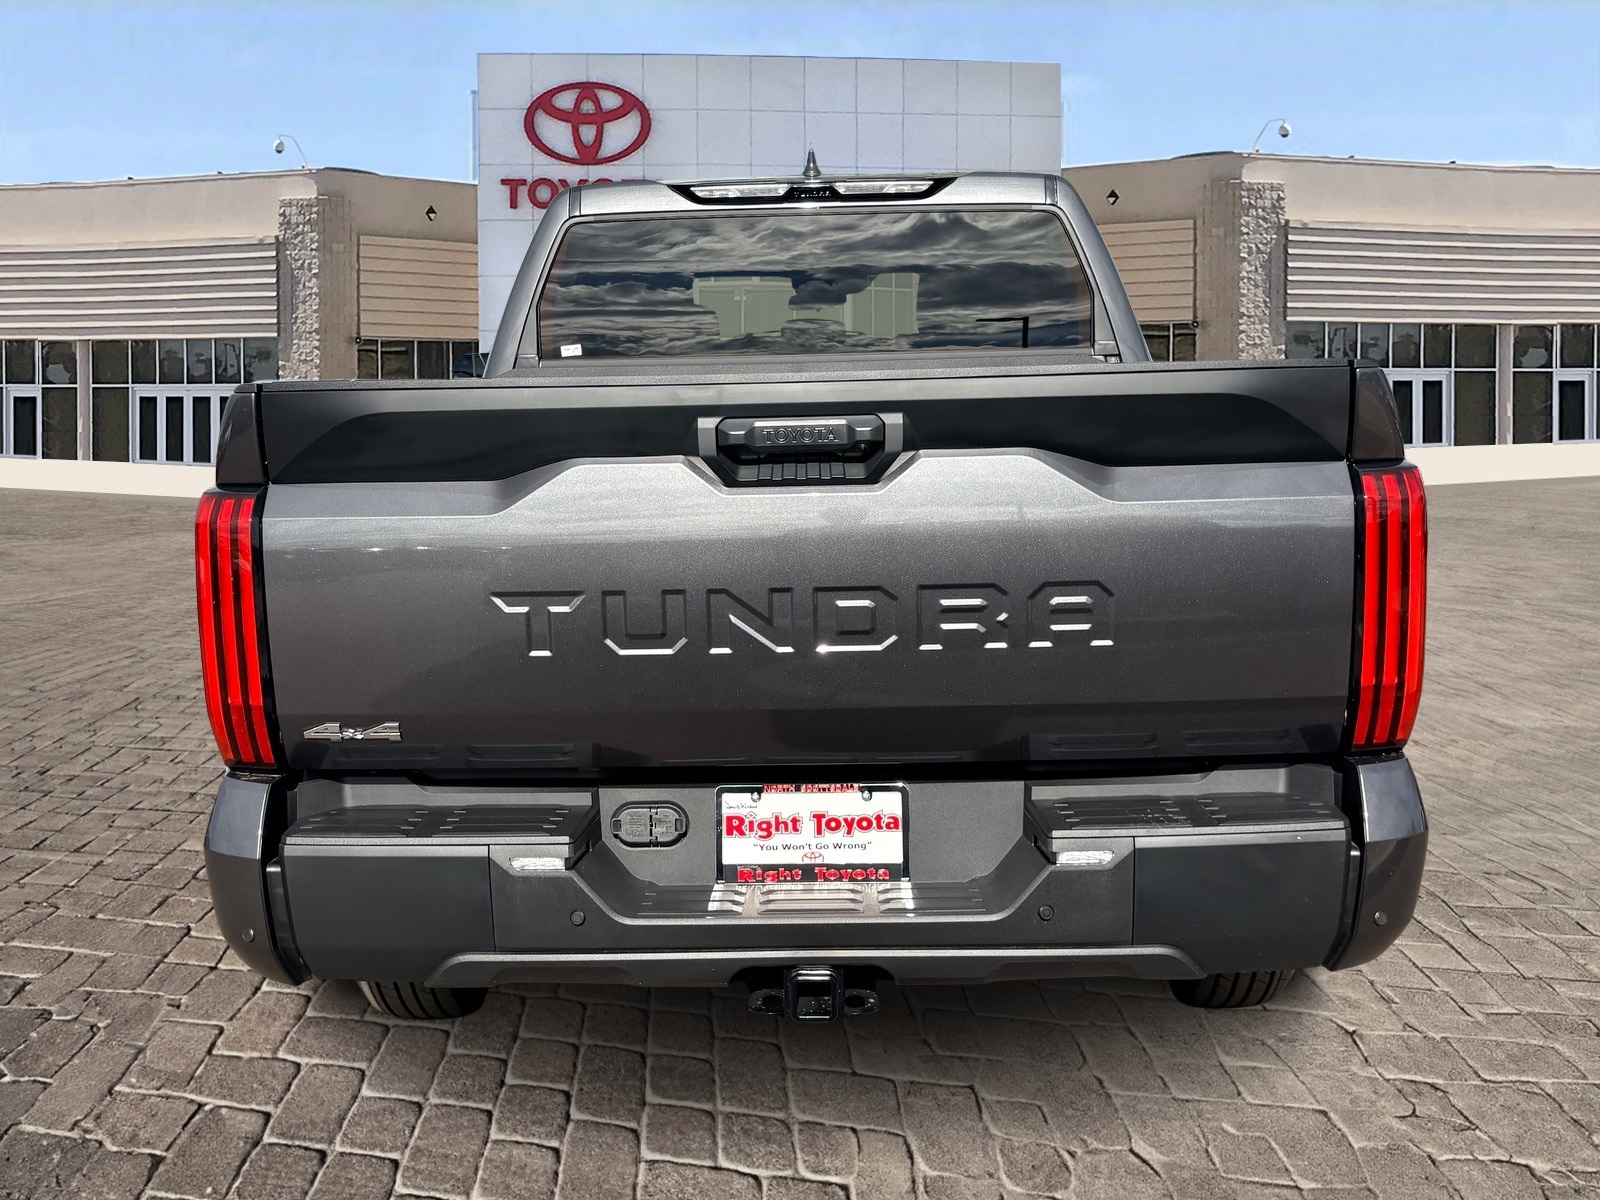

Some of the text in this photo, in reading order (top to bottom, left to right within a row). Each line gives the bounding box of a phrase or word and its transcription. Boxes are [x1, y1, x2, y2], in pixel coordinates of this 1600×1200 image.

[763, 426, 839, 443] TOYOTA
[490, 580, 1115, 658] TUNDRA
[724, 811, 902, 840] Right Toyota
[782, 842, 812, 851] Won't
[815, 842, 829, 850] Go
[737, 866, 891, 883] Right Toyota
